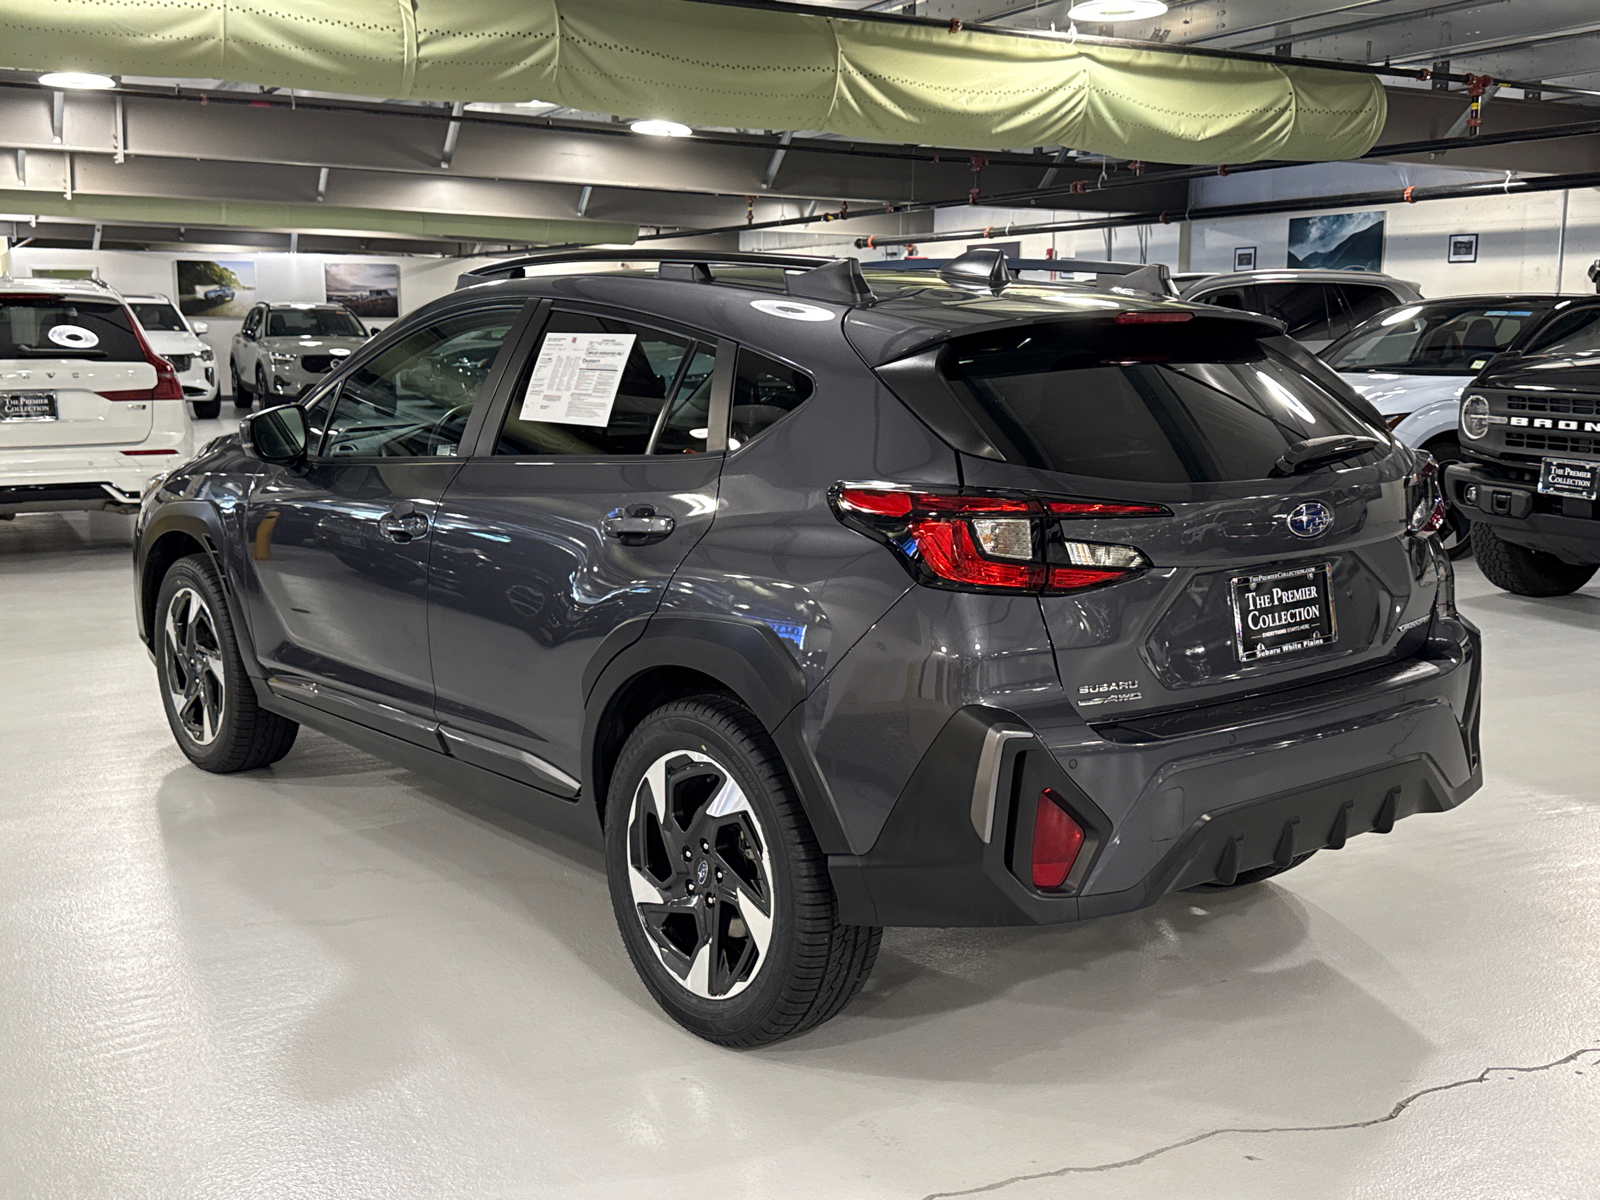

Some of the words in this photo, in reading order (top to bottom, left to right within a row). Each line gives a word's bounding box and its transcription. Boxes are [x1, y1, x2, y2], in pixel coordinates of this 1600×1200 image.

[20, 397, 49, 406] PREMIER
[5, 405, 50, 413] COLLECTION
[1550, 465, 1564, 476] THE
[1565, 467, 1592, 479] PREMIER
[1549, 474, 1591, 487] COLLECTION
[1245, 591, 1272, 610] THE
[1272, 586, 1318, 605] PREMIER
[1248, 604, 1320, 630] COLLECTION
[1256, 648, 1280, 658] Subaru
[1282, 643, 1302, 652] White
[1303, 638, 1324, 648] Plains
[1079, 680, 1139, 694] SUBARU
[1103, 692, 1142, 704] AWD
